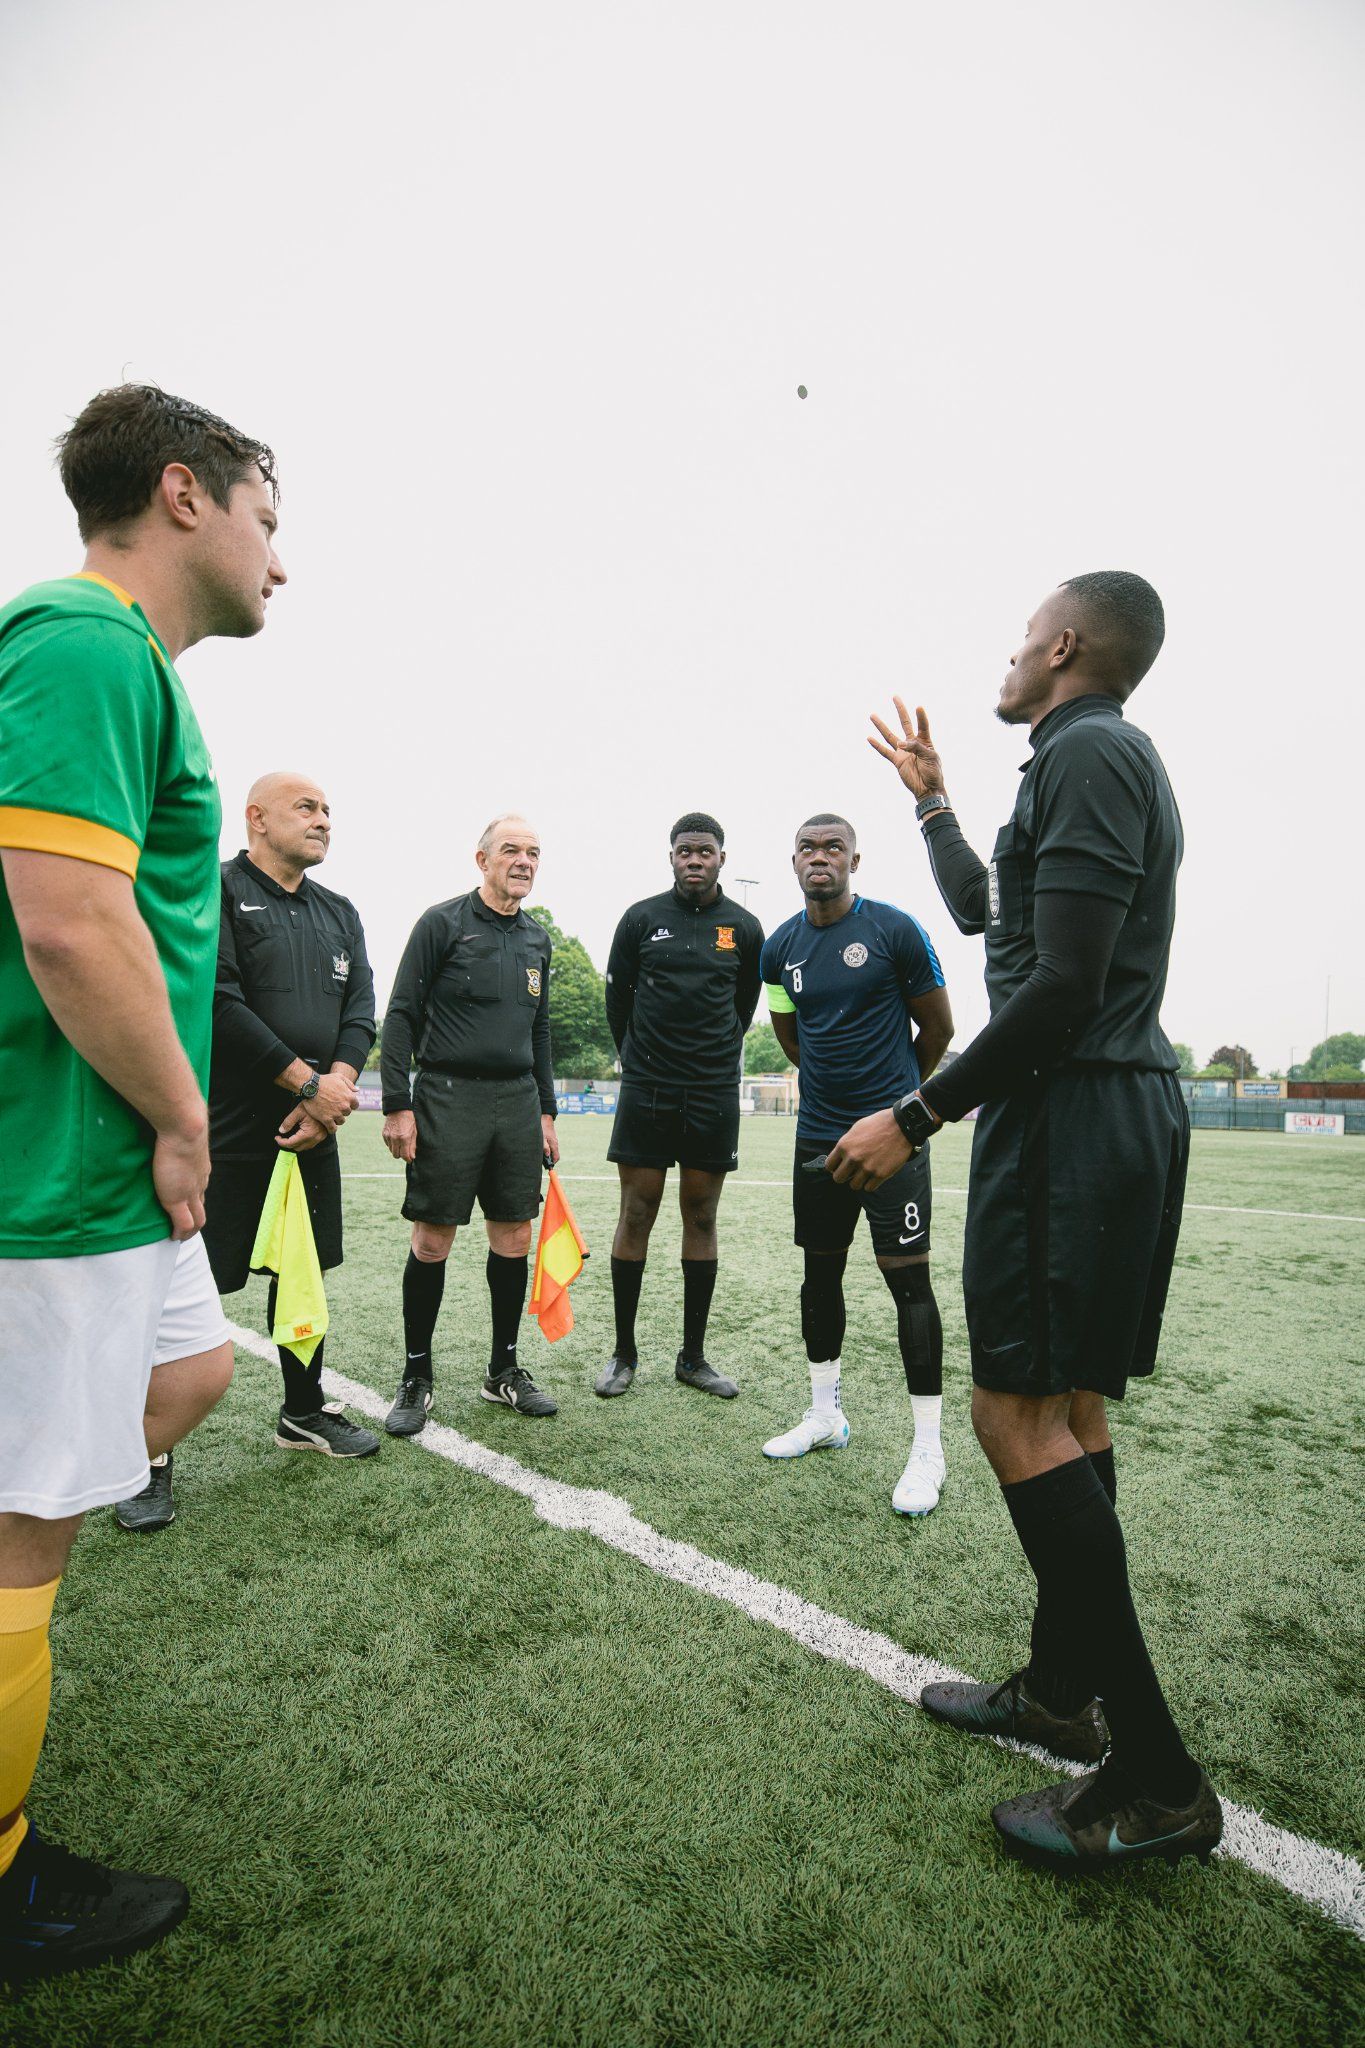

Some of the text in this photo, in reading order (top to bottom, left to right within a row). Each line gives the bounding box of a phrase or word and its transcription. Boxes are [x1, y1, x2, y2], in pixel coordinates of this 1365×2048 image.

[657, 928, 669, 936] EA
[793, 968, 803, 993] 8
[905, 1202, 920, 1230] 8
